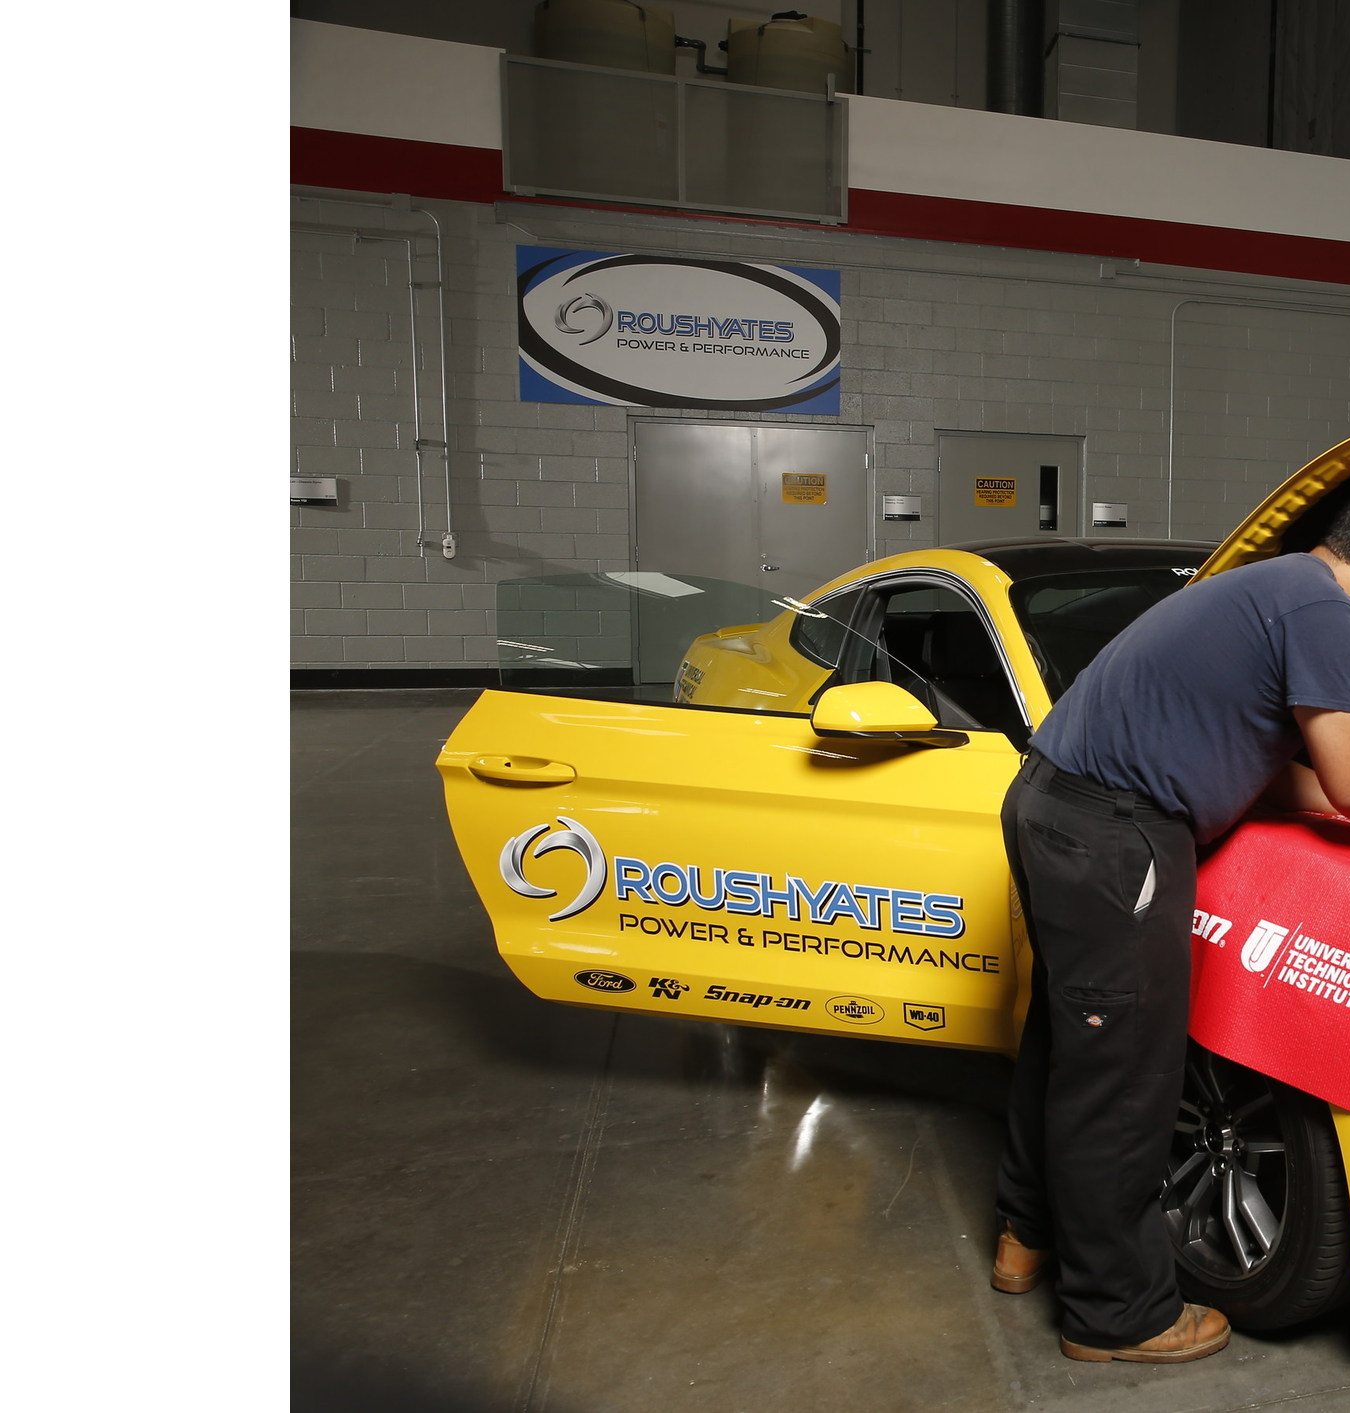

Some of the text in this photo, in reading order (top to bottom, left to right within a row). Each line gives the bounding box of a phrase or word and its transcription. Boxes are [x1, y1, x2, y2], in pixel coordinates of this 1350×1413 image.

[617, 311, 794, 343] ROUSHYATES
[617, 339, 809, 359] POWER & PERFORMANCE
[977, 480, 1014, 489] CAUTION
[1171, 567, 1199, 576] RO
[614, 855, 965, 939] ROUSHYATES
[620, 913, 1000, 973] POWER & PERFORMANCE
[587, 972, 623, 990] Ford
[703, 984, 812, 1011] Snap-on
[833, 1004, 875, 1015] PENNZOIL
[909, 1009, 939, 1022] WD-40
